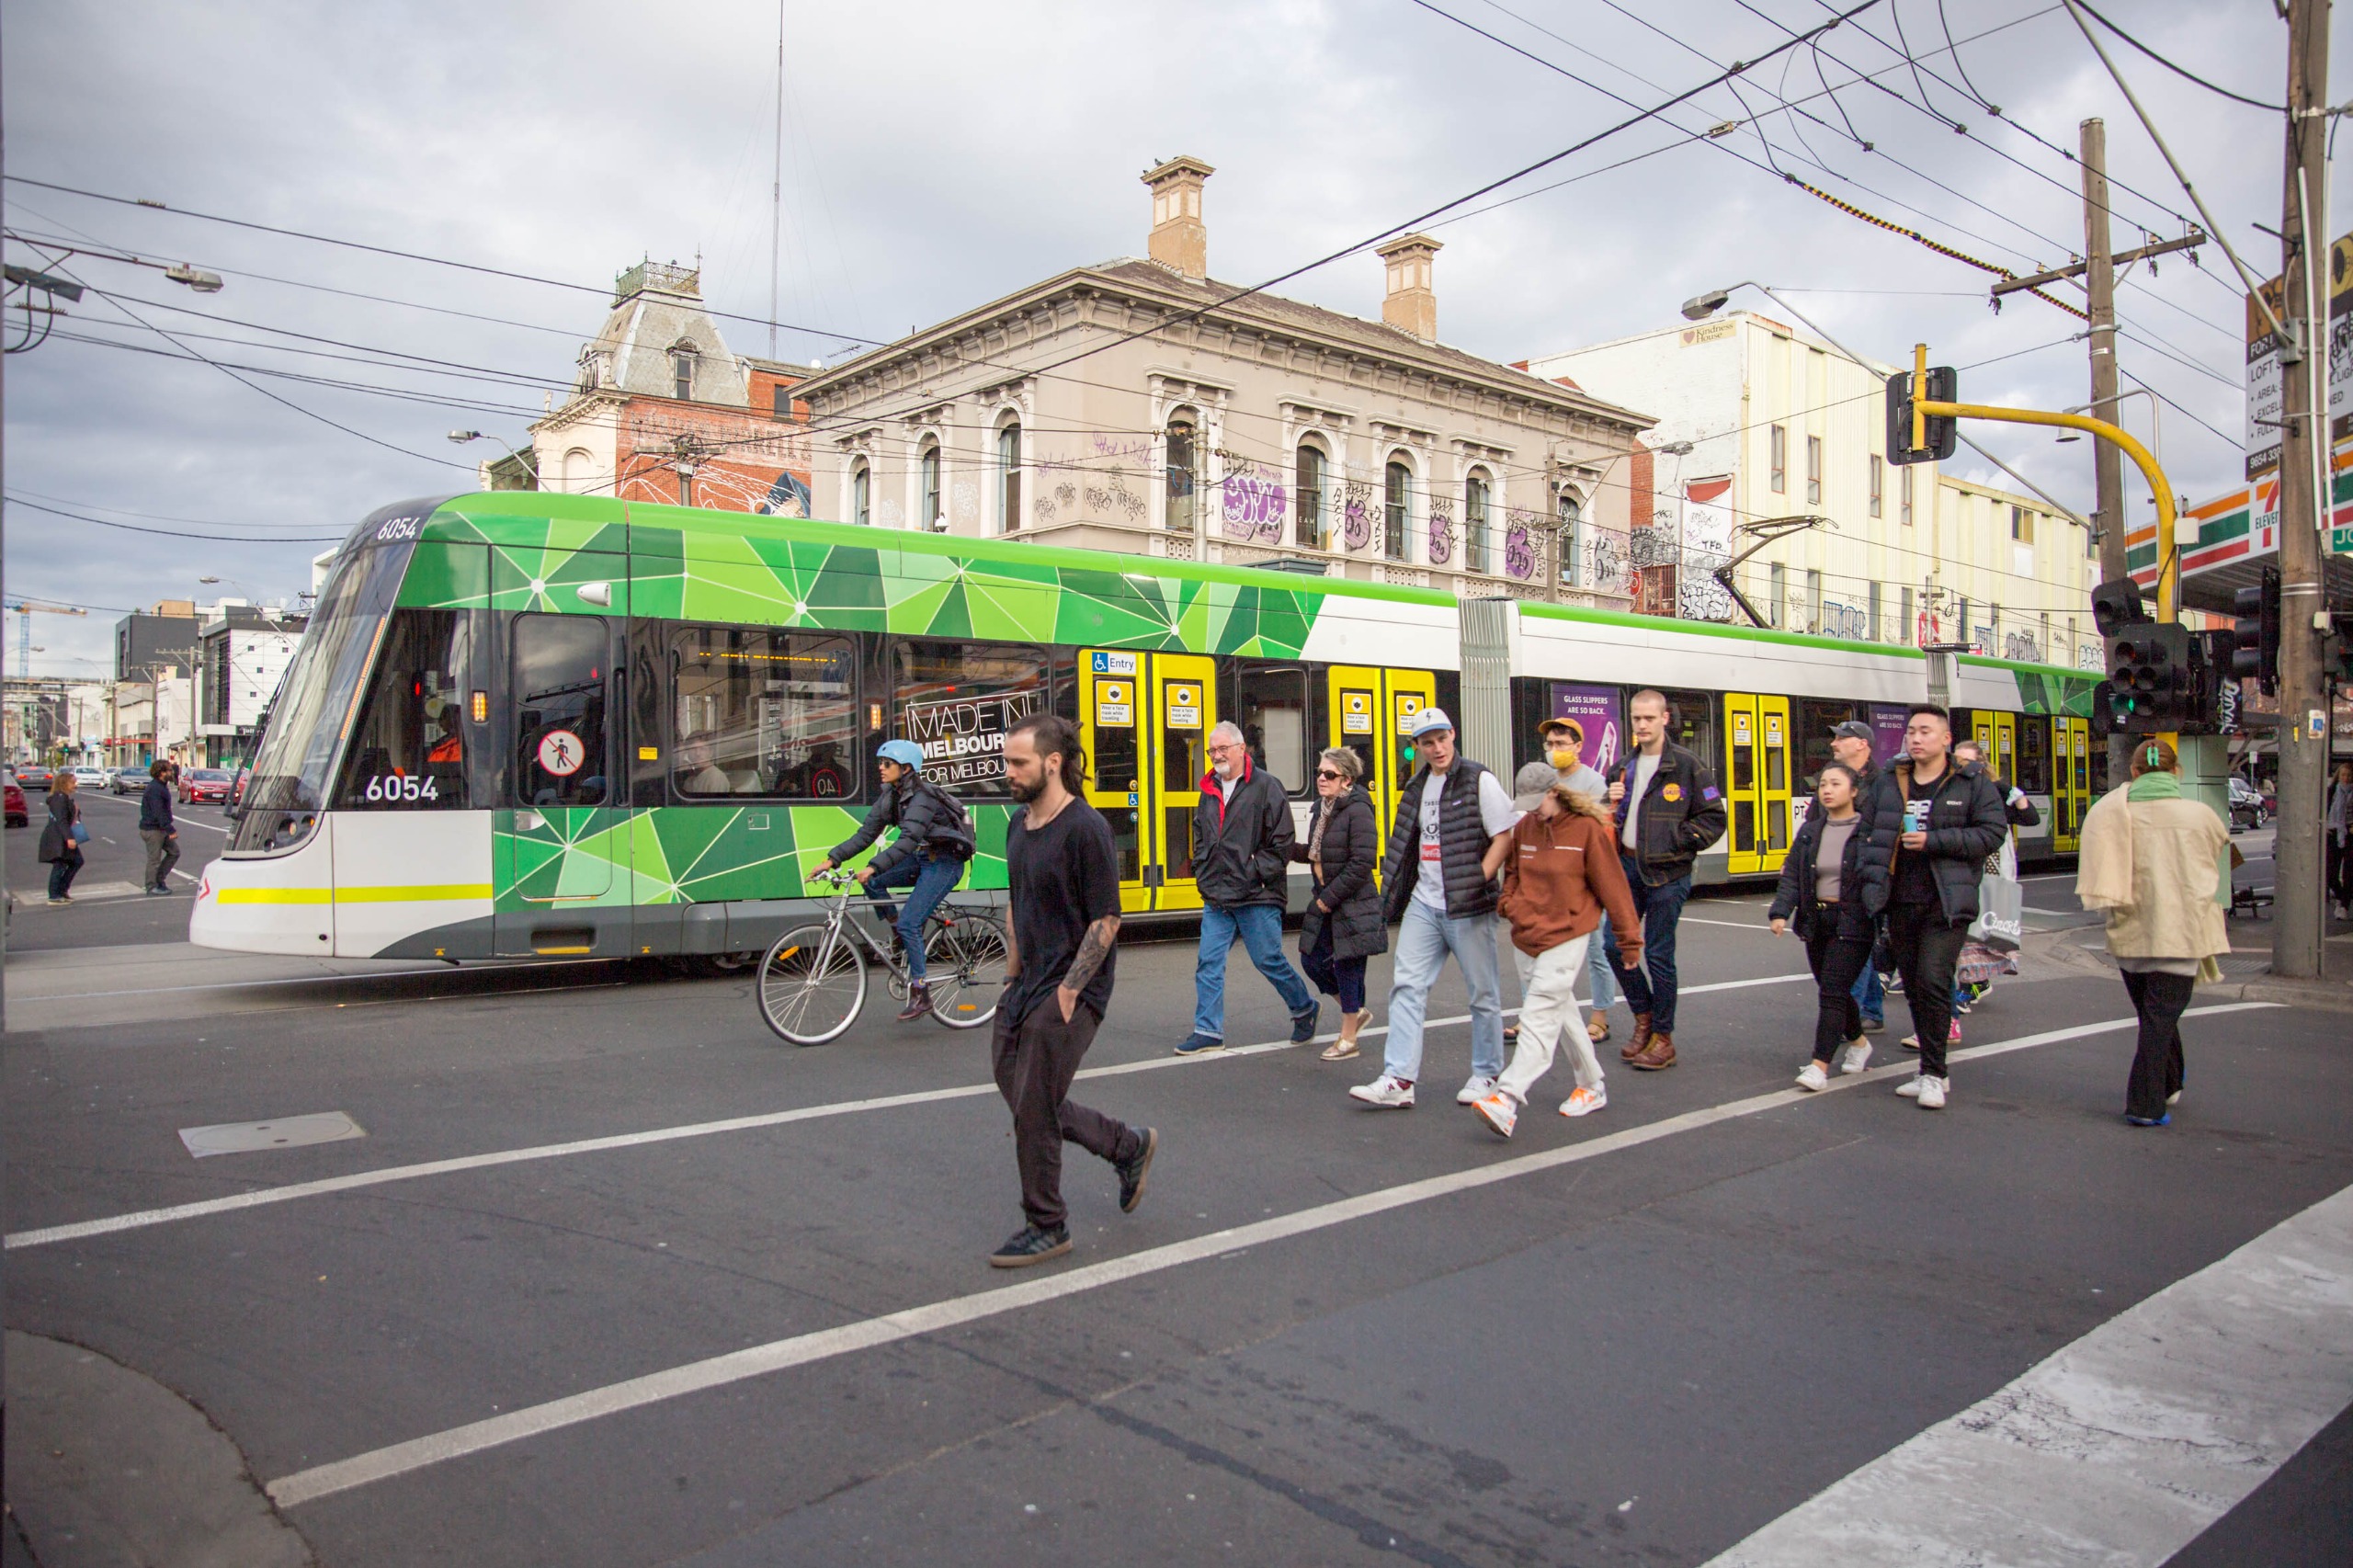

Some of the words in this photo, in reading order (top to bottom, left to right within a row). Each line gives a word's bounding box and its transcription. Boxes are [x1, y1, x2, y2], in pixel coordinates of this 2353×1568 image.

[1697, 323, 1733, 335] Kindness
[1697, 333, 1722, 343] House
[2250, 338, 2268, 358] FOR
[2251, 358, 2274, 382] LOFT
[2257, 384, 2278, 402] AREA:
[378, 517, 420, 540] 6054
[1109, 658, 1134, 671] Entry
[1583, 697, 1608, 705] SLIPPERS
[912, 701, 997, 740] MADE
[1002, 697, 1027, 728] IN
[918, 733, 1005, 759] MELBOUR
[919, 767, 949, 783] FOR
[950, 758, 1007, 779] MELBOU
[367, 775, 438, 801] 6054
